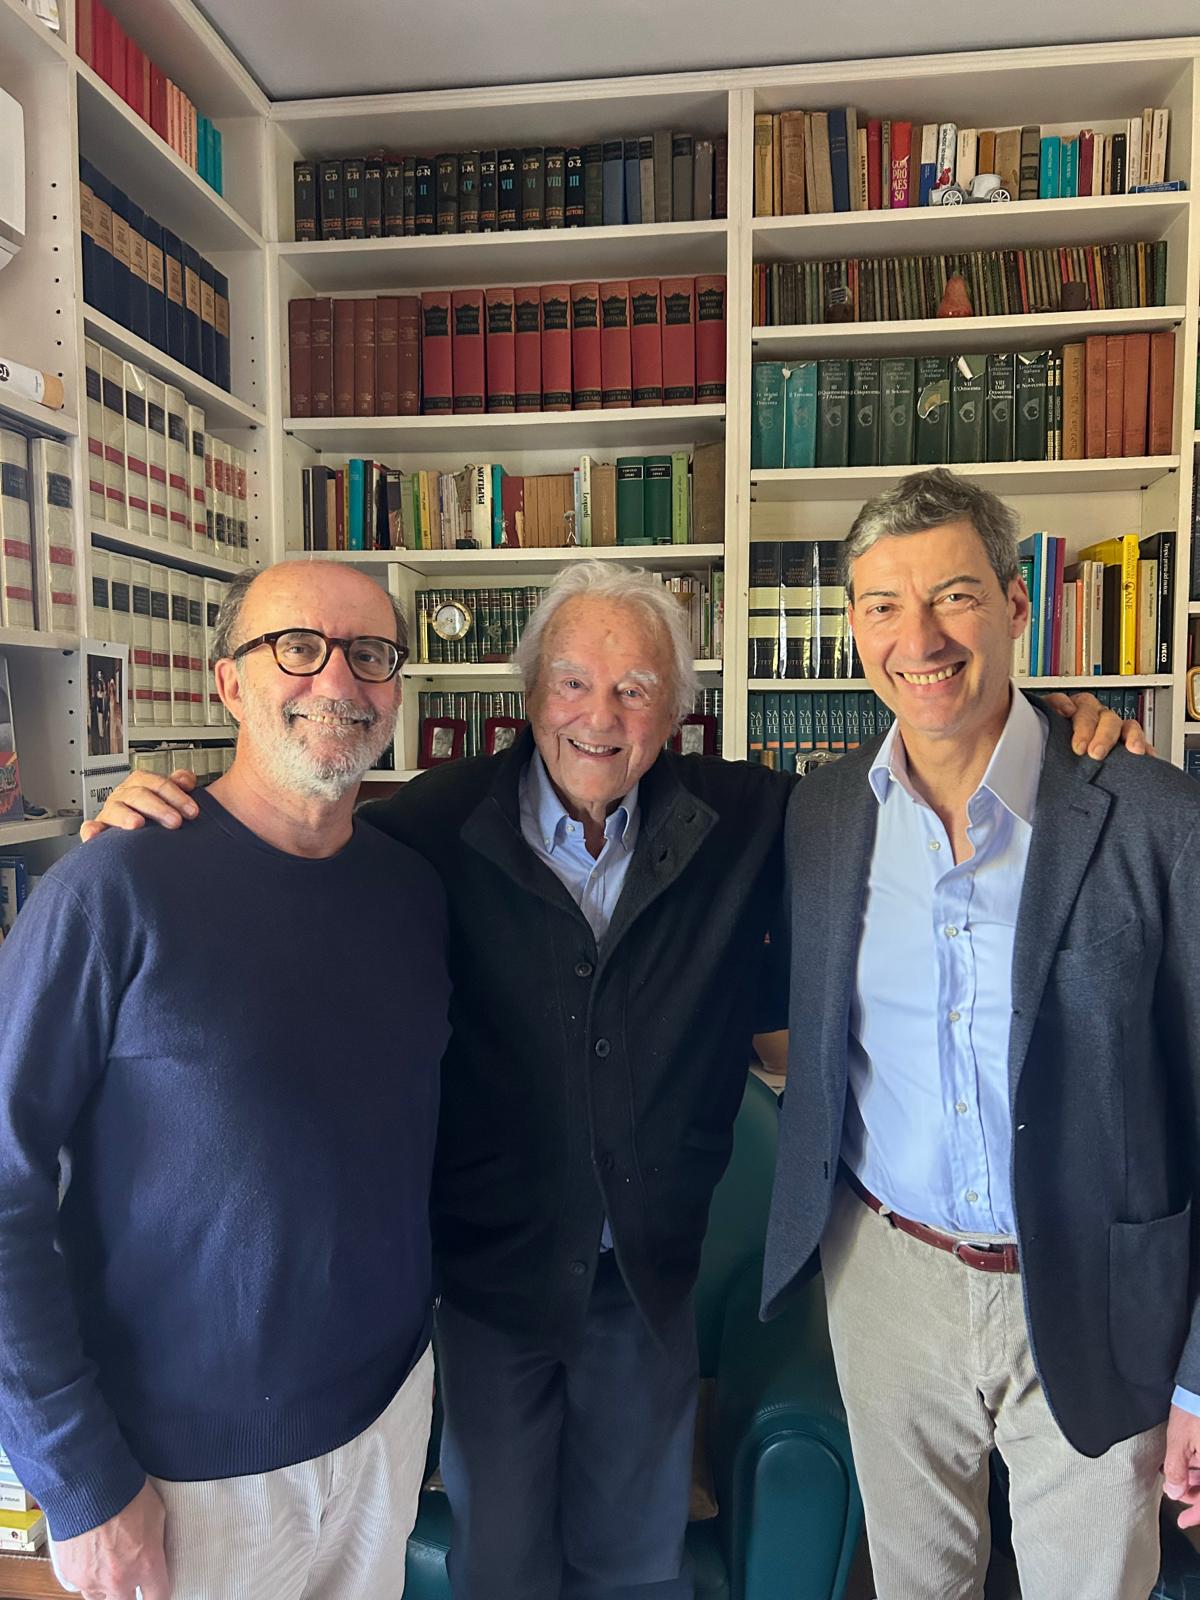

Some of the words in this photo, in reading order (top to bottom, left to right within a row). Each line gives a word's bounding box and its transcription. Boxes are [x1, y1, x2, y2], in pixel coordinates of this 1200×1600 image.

[462, 163, 475, 173] I-M
[548, 160, 561, 168] A-Z
[568, 160, 581, 169] O-Z
[416, 168, 430, 177] G-N
[893, 169, 907, 179] PRO
[325, 173, 338, 181] C-D
[892, 180, 908, 190] MES
[895, 191, 905, 201] SO
[476, 465, 485, 505] PAPILLON
[750, 711, 762, 719] SA
[766, 709, 778, 717] SA
[782, 709, 795, 717] SA
[799, 709, 811, 717] SA
[815, 709, 827, 717] SA
[831, 709, 843, 717] SA
[862, 710, 874, 718] SA
[751, 719, 762, 727] LU
[767, 717, 779, 725] LU
[783, 717, 795, 726] LU
[800, 717, 812, 726] LU
[816, 718, 828, 726] LU
[832, 718, 843, 726] LU
[847, 718, 859, 726] LU
[863, 718, 875, 726] LU
[879, 718, 890, 726] LU
[751, 727, 762, 736] TE
[767, 726, 779, 734] TE
[784, 726, 795, 734] TE
[800, 726, 812, 734] TE
[816, 726, 827, 734] TE
[832, 726, 843, 734] TE
[847, 727, 859, 735] TE
[863, 727, 875, 735] TE
